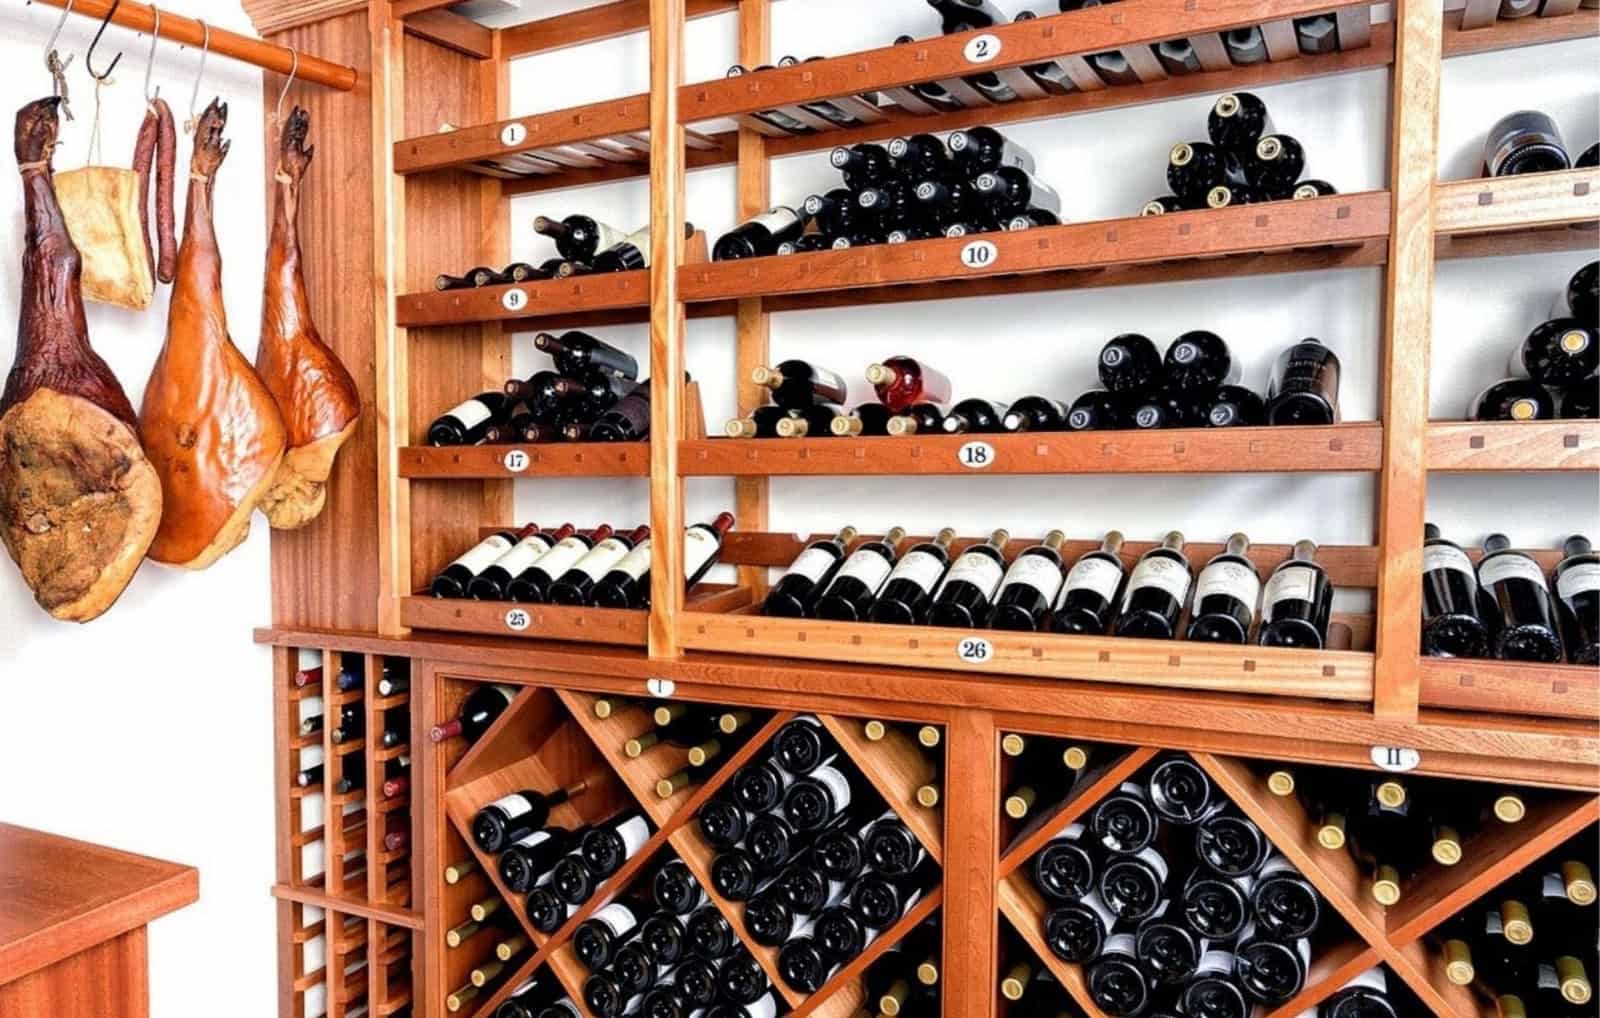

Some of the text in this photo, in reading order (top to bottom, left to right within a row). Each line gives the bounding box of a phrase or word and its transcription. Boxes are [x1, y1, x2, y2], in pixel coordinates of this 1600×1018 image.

[976, 40, 988, 58] 2
[967, 246, 989, 264] 10
[510, 293, 519, 307] 9
[510, 454, 524, 467] 17
[966, 446, 987, 464] 18
[510, 612, 525, 626] 25
[964, 641, 986, 659] 26
